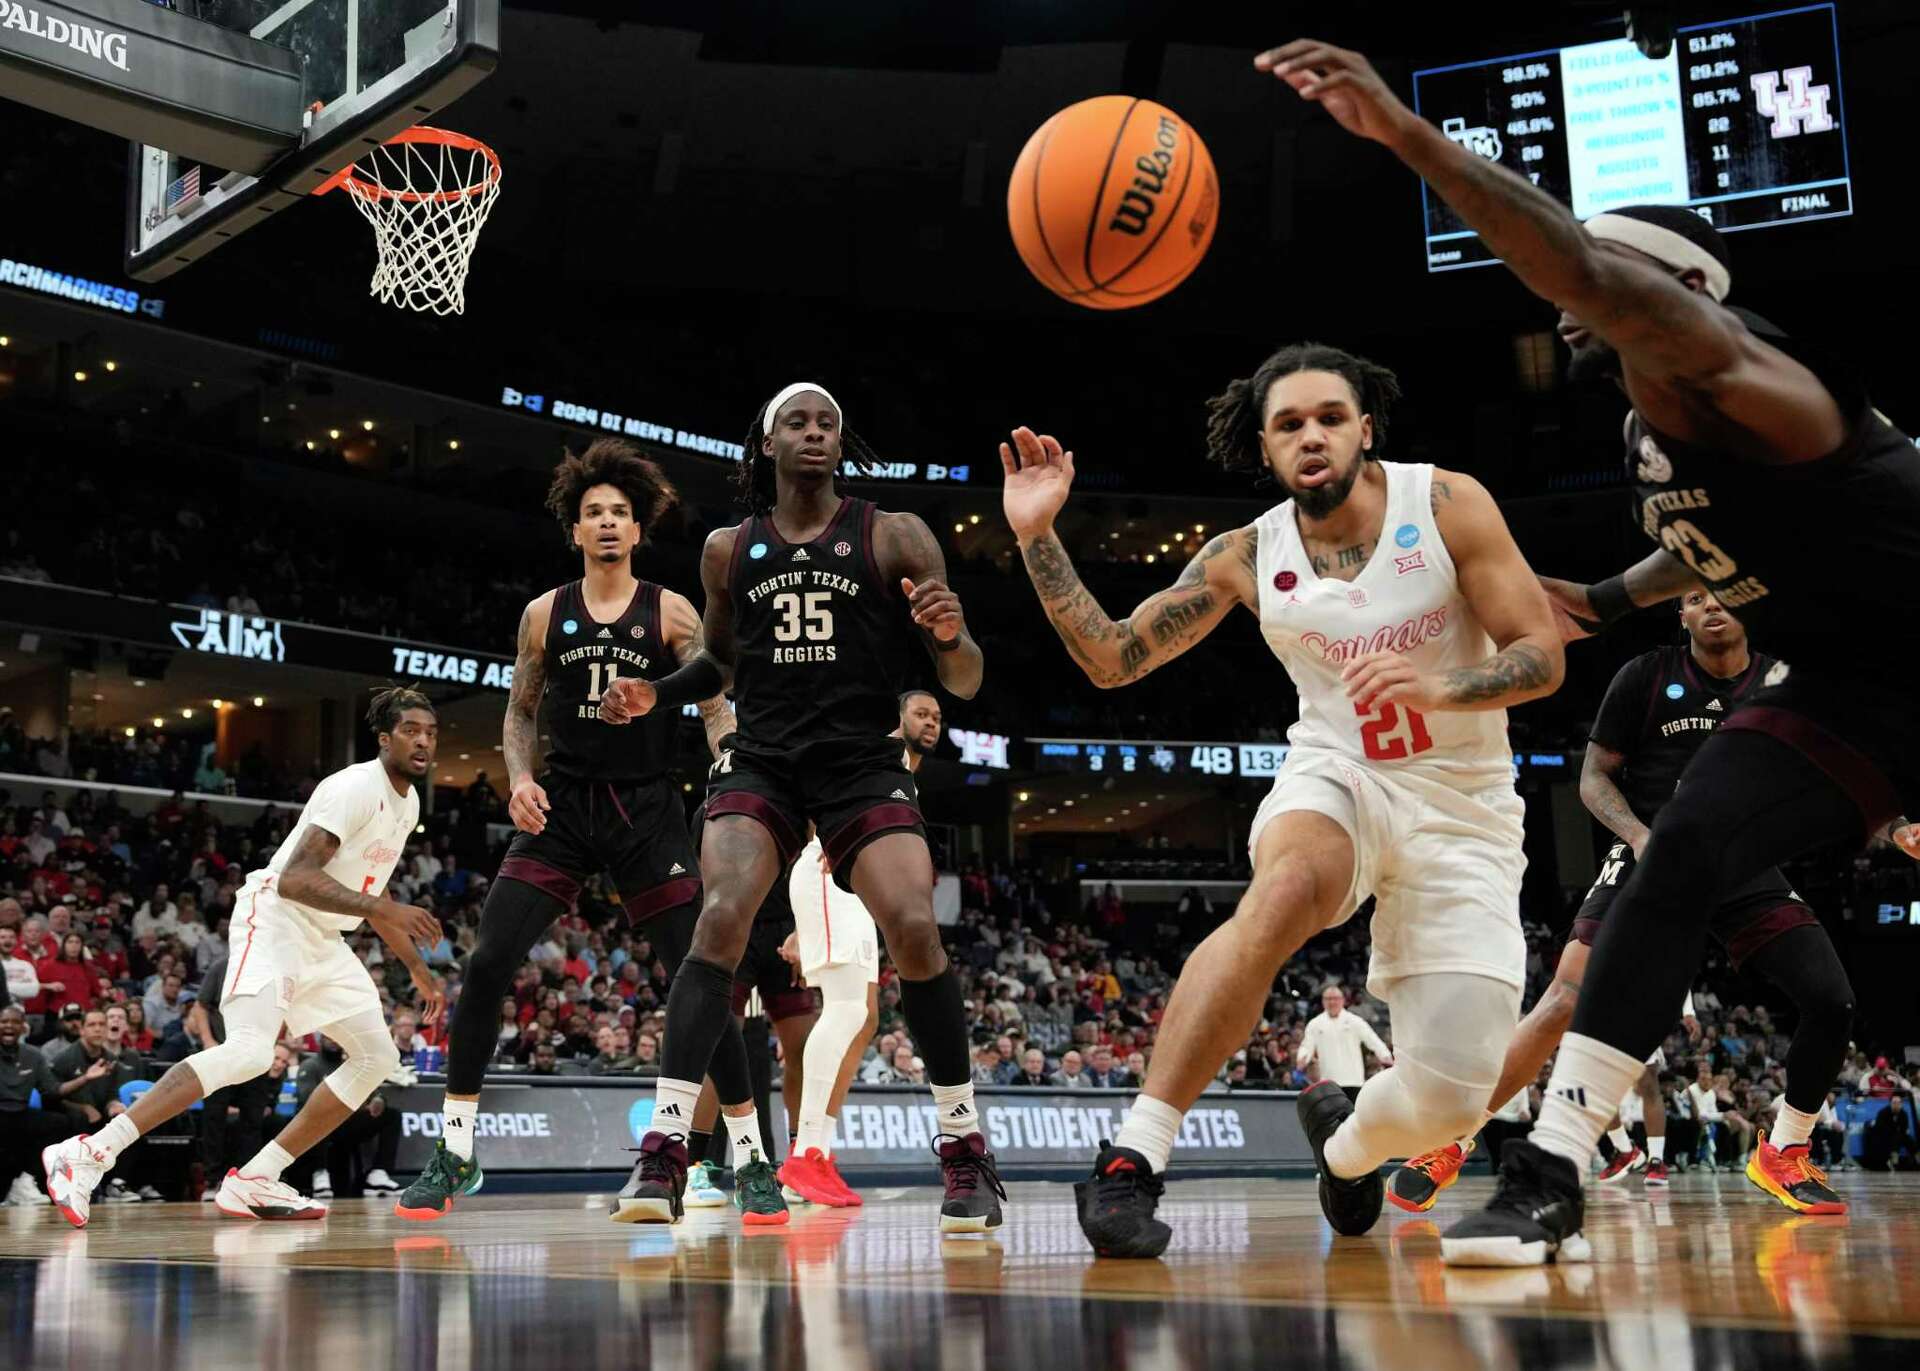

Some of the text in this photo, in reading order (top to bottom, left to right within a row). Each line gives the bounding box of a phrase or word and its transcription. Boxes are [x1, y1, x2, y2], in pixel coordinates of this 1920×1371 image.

[1109, 115, 1179, 237] Wilson
[1781, 192, 1830, 213] FINAL
[552, 400, 598, 426] 2024
[624, 417, 674, 444] MEN'S
[747, 571, 860, 603] FIGHTIN' TEXAS
[773, 591, 834, 642] 35
[393, 647, 478, 683] TEXAS
[559, 645, 649, 669] FIGHTIN' TEXAS
[773, 645, 836, 664] AGGIES
[1354, 694, 1433, 761] 21
[1661, 717, 1717, 737] FIGHTIN'
[1190, 746, 1233, 774] 48
[401, 1111, 551, 1138] PORADE
